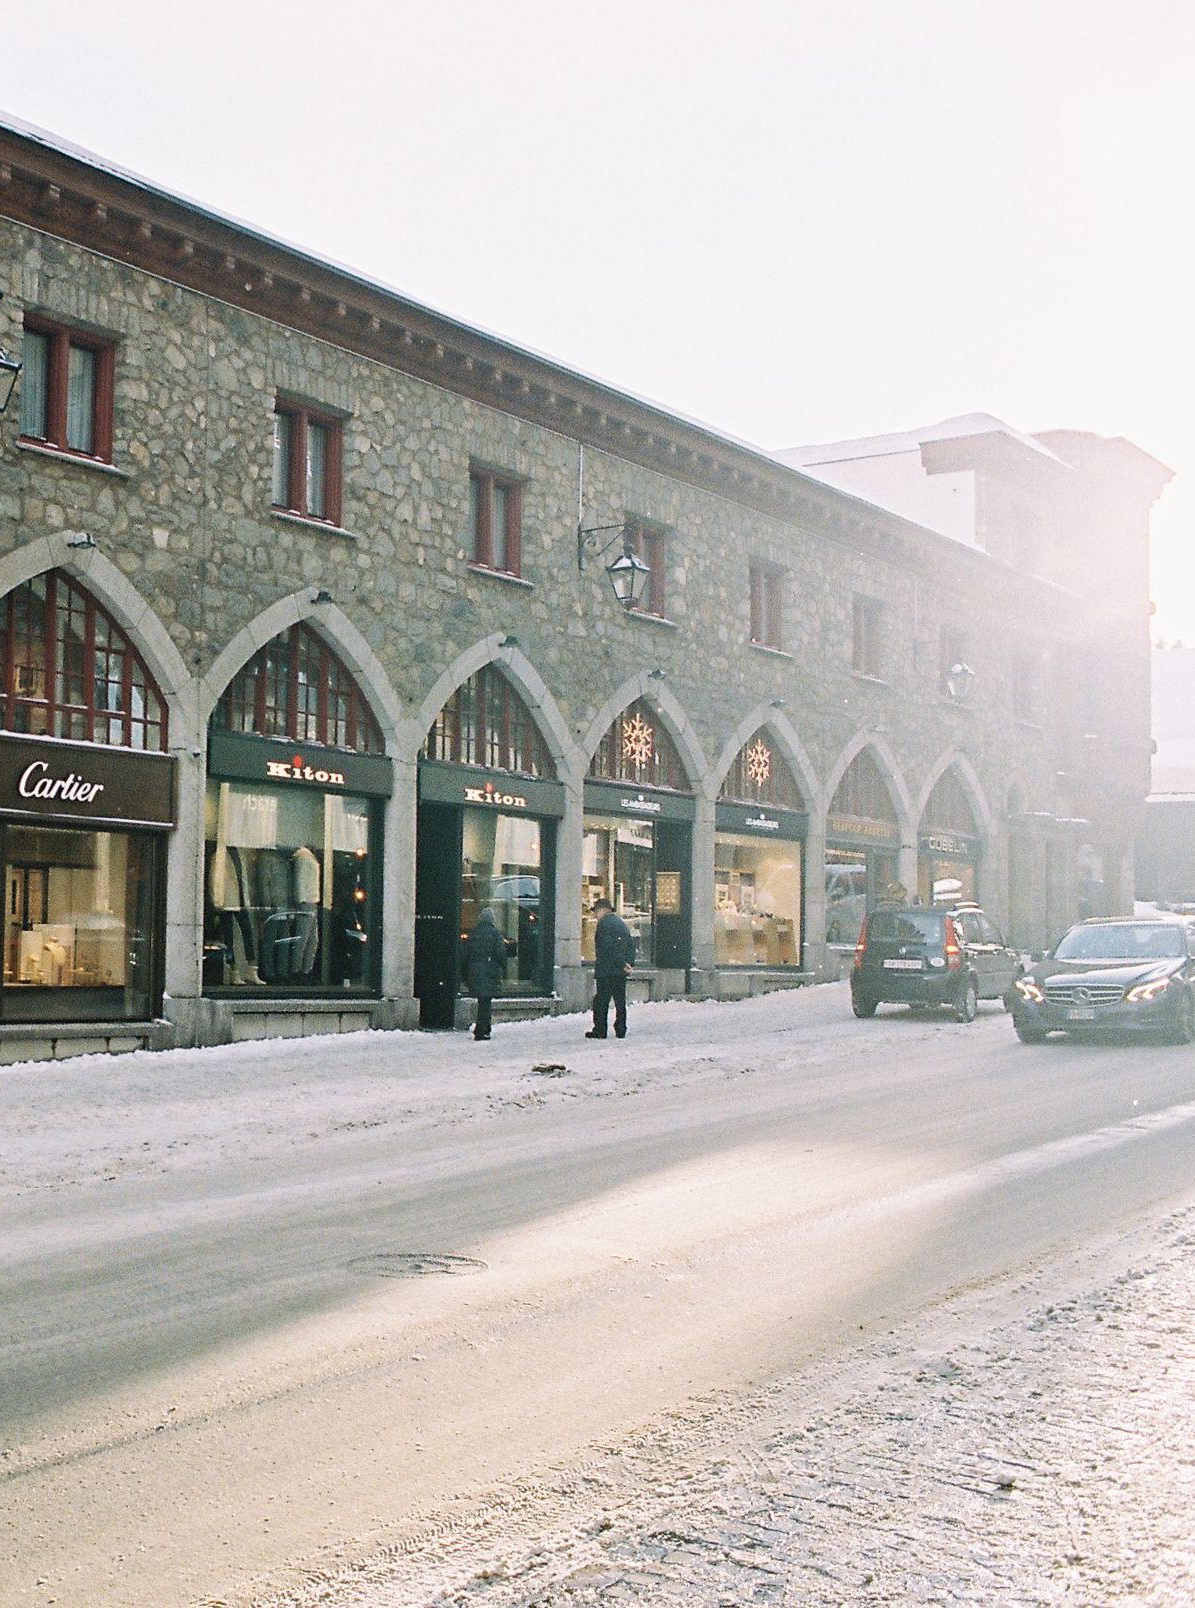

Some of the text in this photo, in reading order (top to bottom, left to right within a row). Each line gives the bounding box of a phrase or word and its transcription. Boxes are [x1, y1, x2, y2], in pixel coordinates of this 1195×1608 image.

[18, 761, 105, 803] Cartier
[266, 754, 345, 785] Kiton
[464, 782, 527, 808] Kiton
